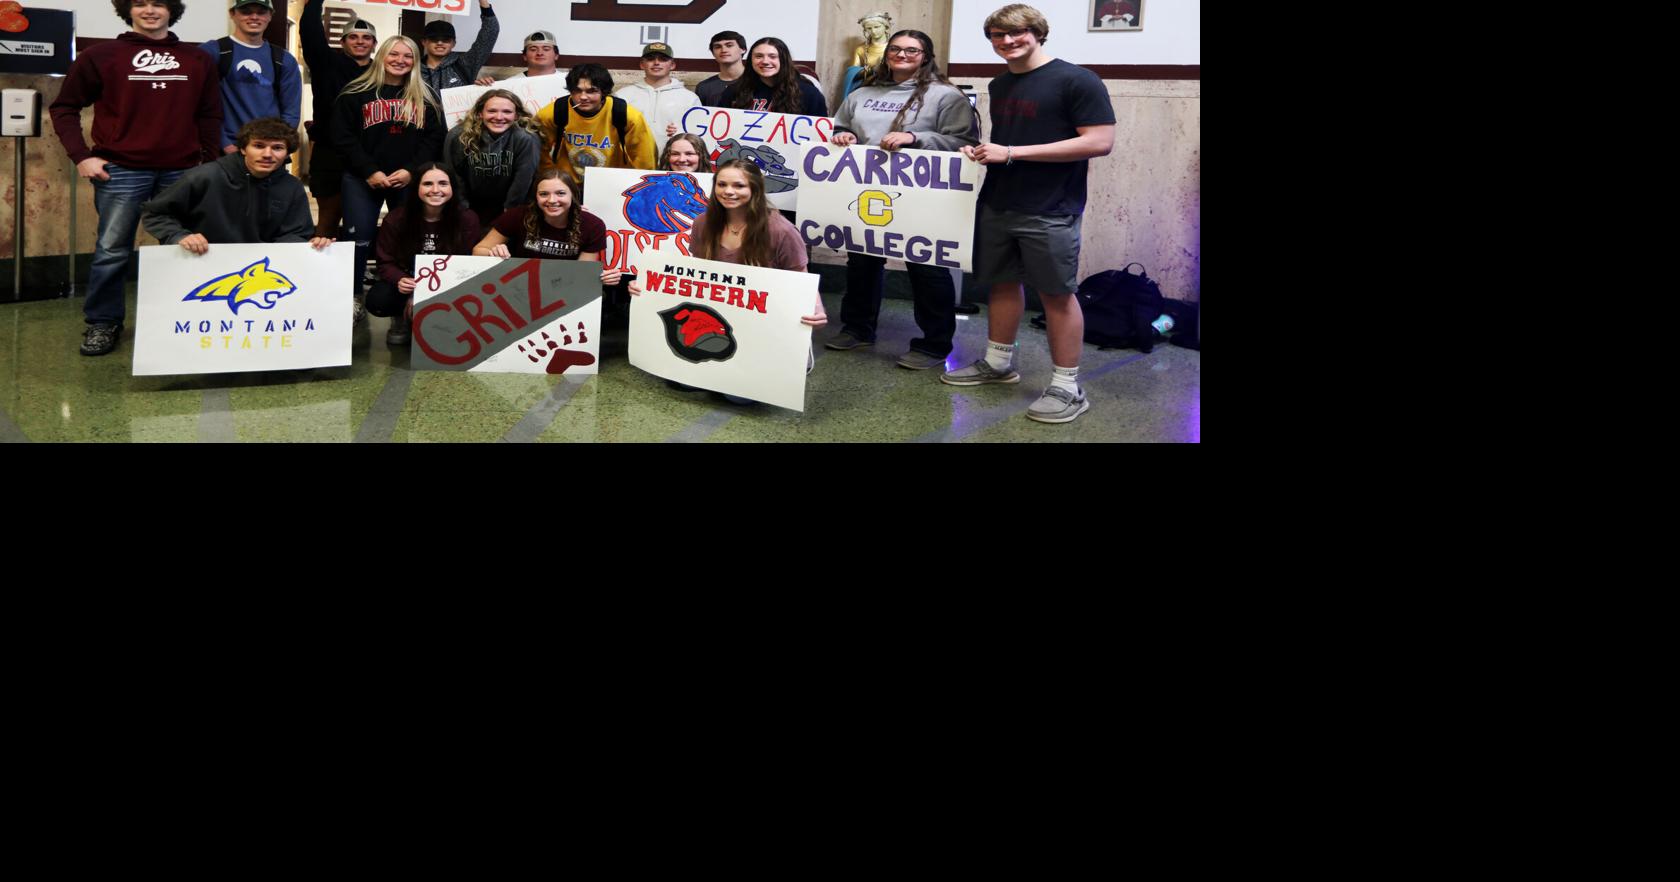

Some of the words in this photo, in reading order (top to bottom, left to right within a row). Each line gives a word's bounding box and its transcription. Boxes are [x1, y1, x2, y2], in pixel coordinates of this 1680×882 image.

[132, 49, 180, 73] Griz
[362, 98, 425, 129] MONT
[681, 106, 731, 140] GO
[739, 111, 834, 145] ZAGS
[803, 146, 973, 191] CARROLL
[800, 219, 960, 268] COLLEGE
[663, 264, 746, 286] MONTANA
[646, 270, 769, 314] WESTERN
[174, 318, 315, 333] MONTANA
[200, 335, 293, 349] STATE
